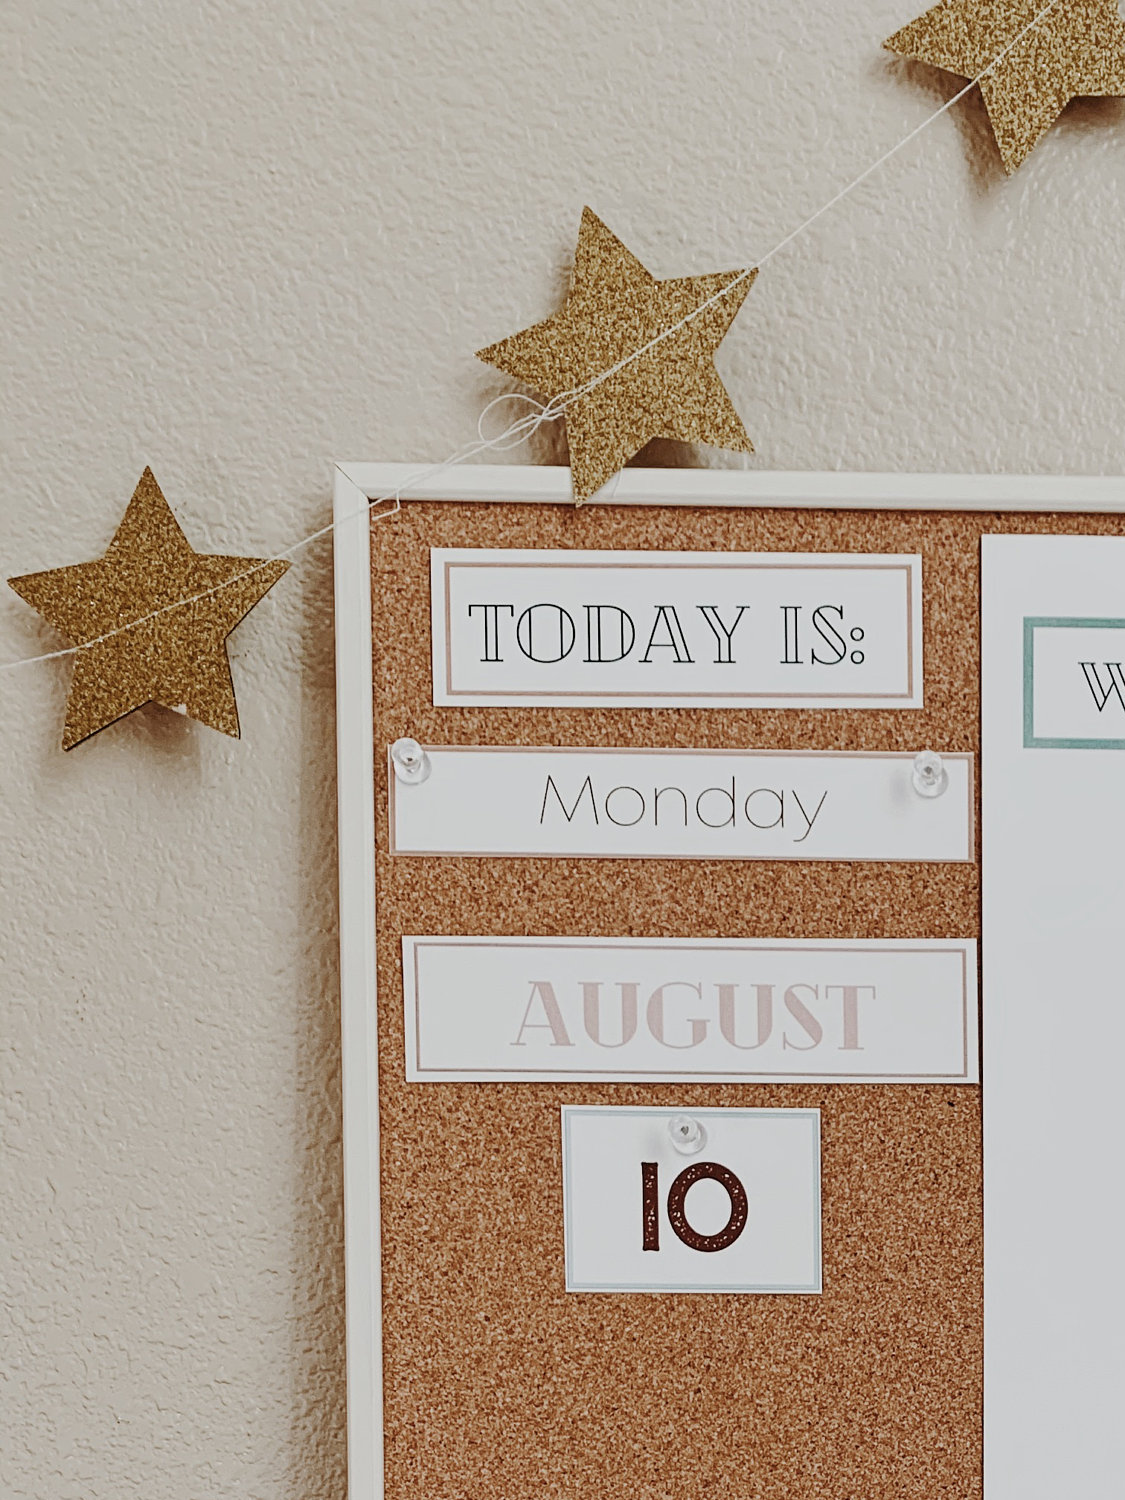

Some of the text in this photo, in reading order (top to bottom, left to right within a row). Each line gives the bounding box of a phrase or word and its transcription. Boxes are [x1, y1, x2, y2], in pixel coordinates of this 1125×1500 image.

[469, 604, 864, 665] TODAY IS:
[540, 775, 827, 842] Monday
[510, 981, 876, 1050] AUGUST
[641, 1162, 748, 1252] 10
